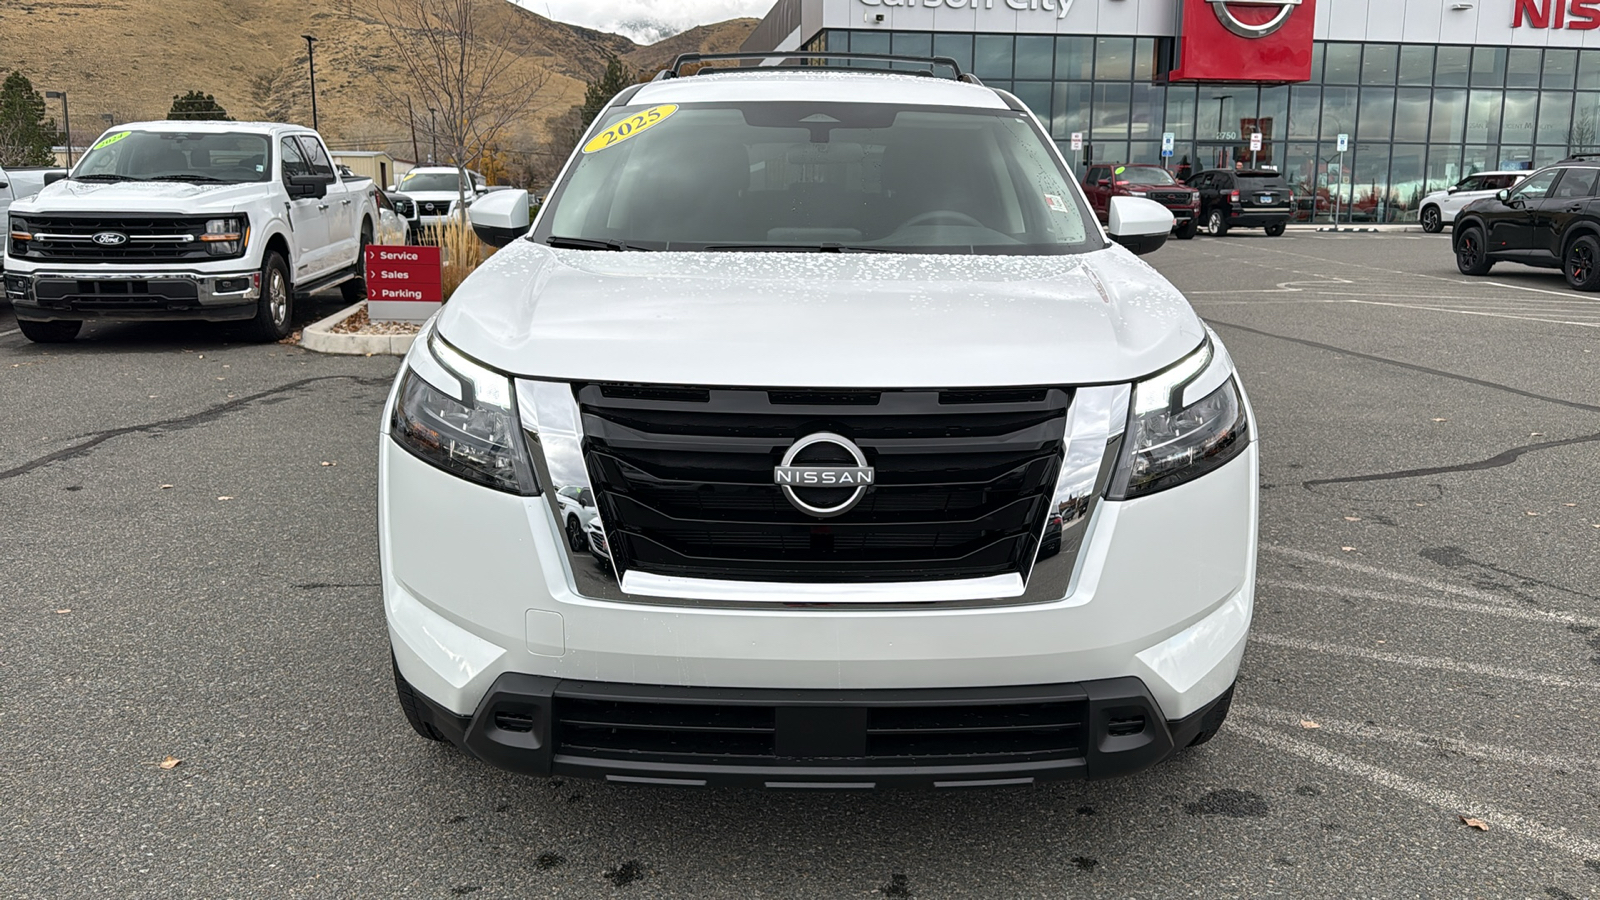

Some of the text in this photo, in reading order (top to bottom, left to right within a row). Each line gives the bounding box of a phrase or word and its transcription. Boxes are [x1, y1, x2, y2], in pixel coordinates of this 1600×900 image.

[602, 108, 661, 145] 2025
[1216, 131, 1237, 140] 2750
[99, 233, 120, 243] Ford
[380, 251, 418, 260] Service
[381, 270, 409, 279] Sales
[382, 289, 422, 300] Parking
[777, 470, 872, 483] NISSAN
